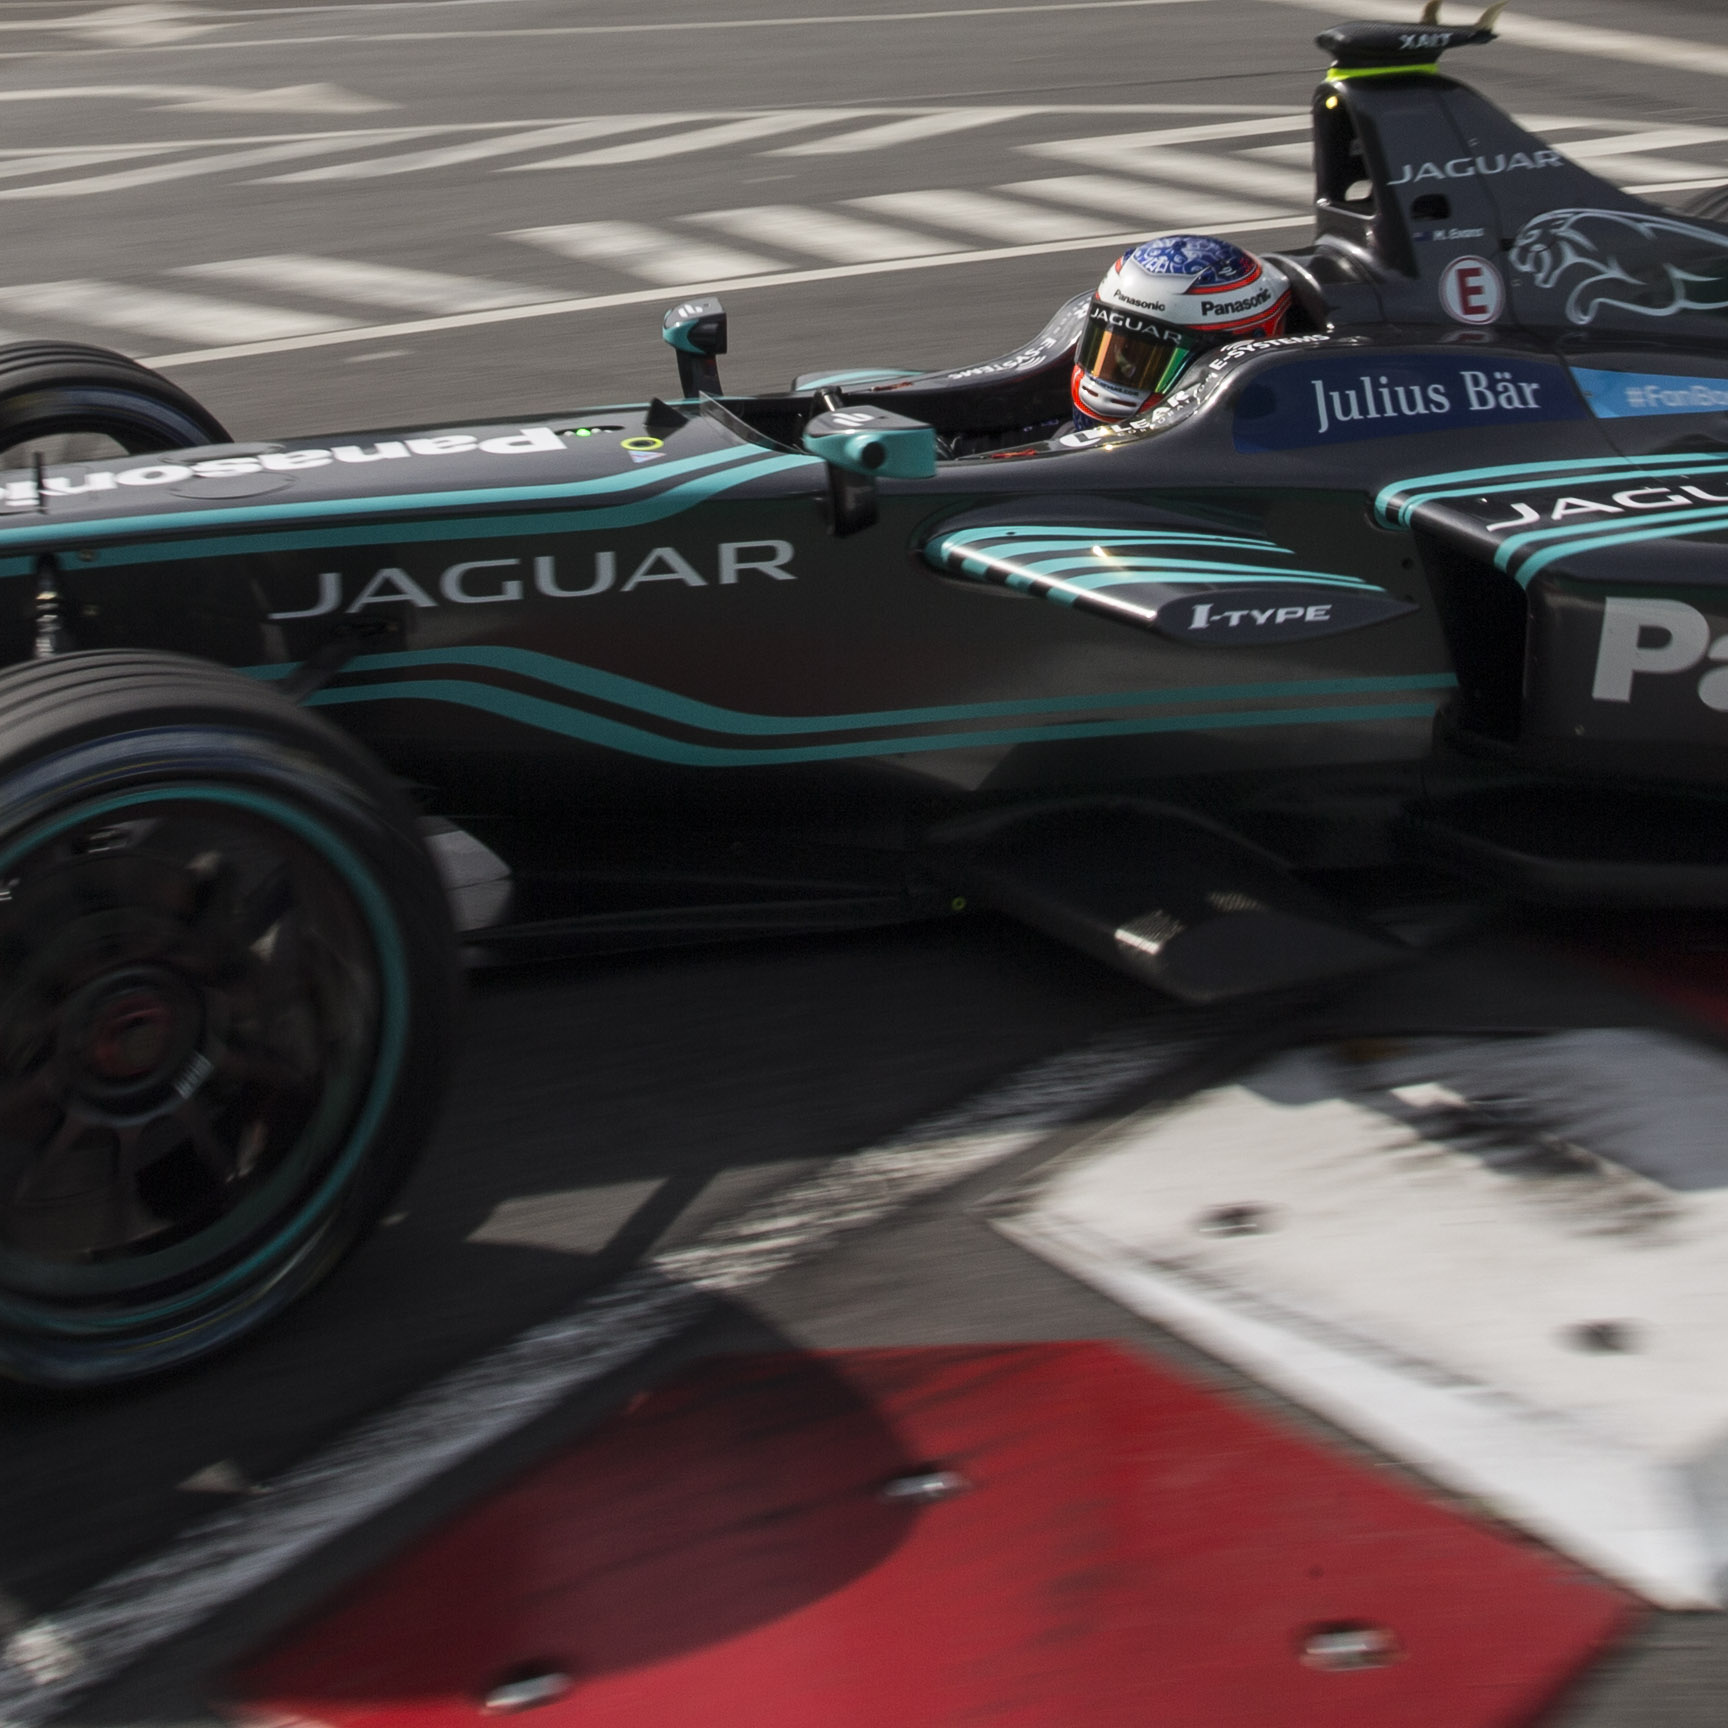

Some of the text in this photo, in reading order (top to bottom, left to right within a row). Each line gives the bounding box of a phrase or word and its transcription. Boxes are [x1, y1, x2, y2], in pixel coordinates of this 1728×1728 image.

[1386, 149, 1567, 186] JAGUAR
[1113, 288, 1166, 313] Panasonic
[1201, 287, 1272, 317] Panasonic
[1455, 266, 1490, 316] E
[1089, 306, 1183, 346] JAGUAR
[1208, 333, 1331, 371] E-SYSTEMS
[1310, 369, 1543, 433] Julius Bär
[268, 538, 798, 620] JAGUAR
[1187, 602, 1333, 630] I-TYPE
